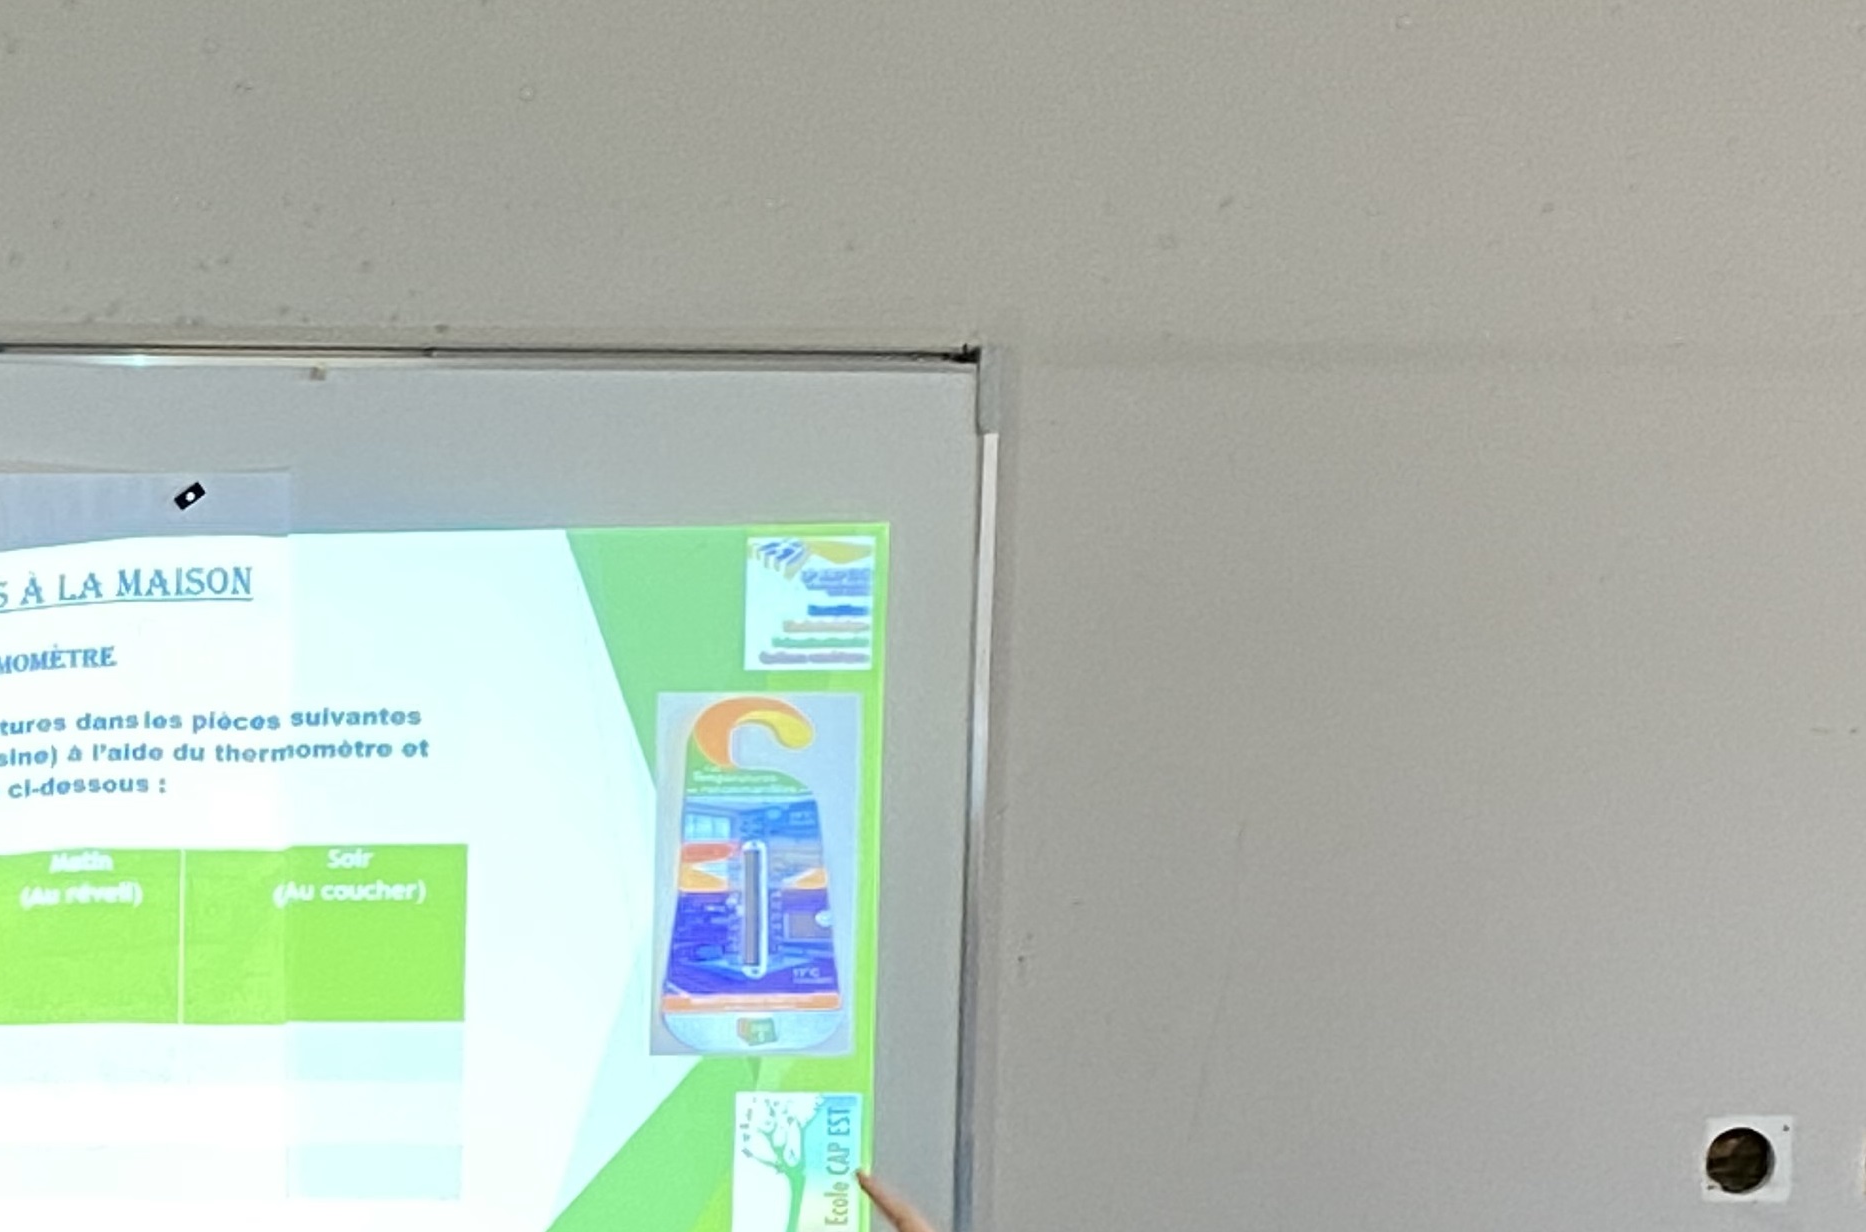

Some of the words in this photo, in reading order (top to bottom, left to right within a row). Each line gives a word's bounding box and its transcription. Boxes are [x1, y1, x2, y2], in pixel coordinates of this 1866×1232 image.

[20, 570, 45, 605] À
[59, 573, 103, 602] LA
[116, 566, 253, 598] MAISON
[76, 712, 139, 732] dans
[173, 742, 205, 762] du
[50, 850, 115, 874] Matin
[327, 848, 375, 870] Soir
[320, 880, 427, 906] coucher)
[826, 1105, 851, 1137] EST
[825, 1141, 851, 1176] CAP
[824, 1181, 850, 1226] Ecole
